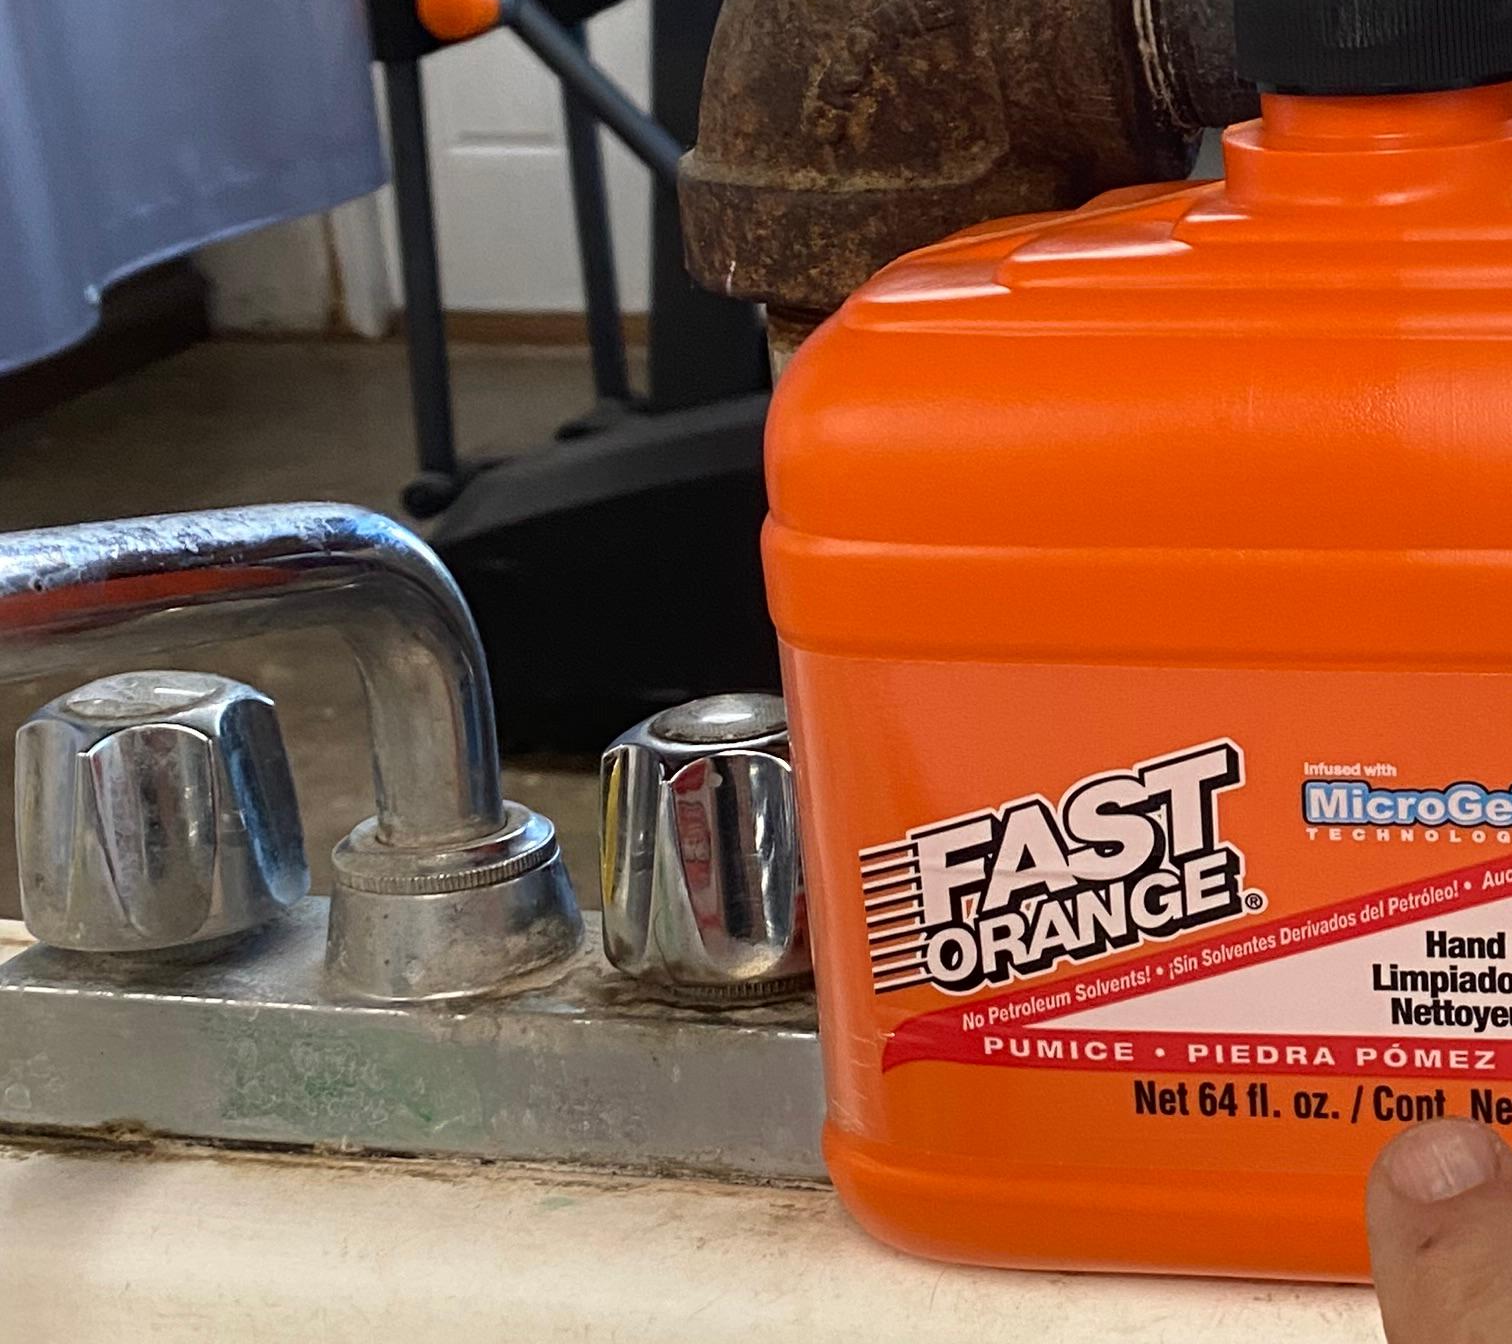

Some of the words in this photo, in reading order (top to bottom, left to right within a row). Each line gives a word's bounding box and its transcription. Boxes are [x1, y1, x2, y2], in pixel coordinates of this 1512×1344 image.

[1303, 762, 1361, 777] Infused
[1364, 762, 1397, 777] with
[911, 743, 1242, 926] FAST
[962, 1012, 985, 1031] No
[988, 992, 1072, 1026] Petroleum
[1075, 965, 1152, 1002] Solvents!
[1168, 955, 1199, 981] ¡Sin
[1201, 933, 1277, 965] Solventes
[1280, 911, 1357, 946] Derivados
[1360, 899, 1385, 923] del
[1388, 879, 1460, 914] Petróleo!
[1425, 930, 1506, 960] Hand
[984, 1037, 1135, 1063] PUMICE
[1187, 1043, 1336, 1067] PIEDRA
[1355, 1042, 1497, 1071] PÓMEZ
[1134, 1080, 1188, 1116] Net
[1198, 1082, 1238, 1117] 64
[1246, 1081, 1281, 1118] fl.
[1293, 1088, 1341, 1120] oz.
[1350, 1084, 1365, 1124] /
[1372, 1084, 1447, 1122] Cont
